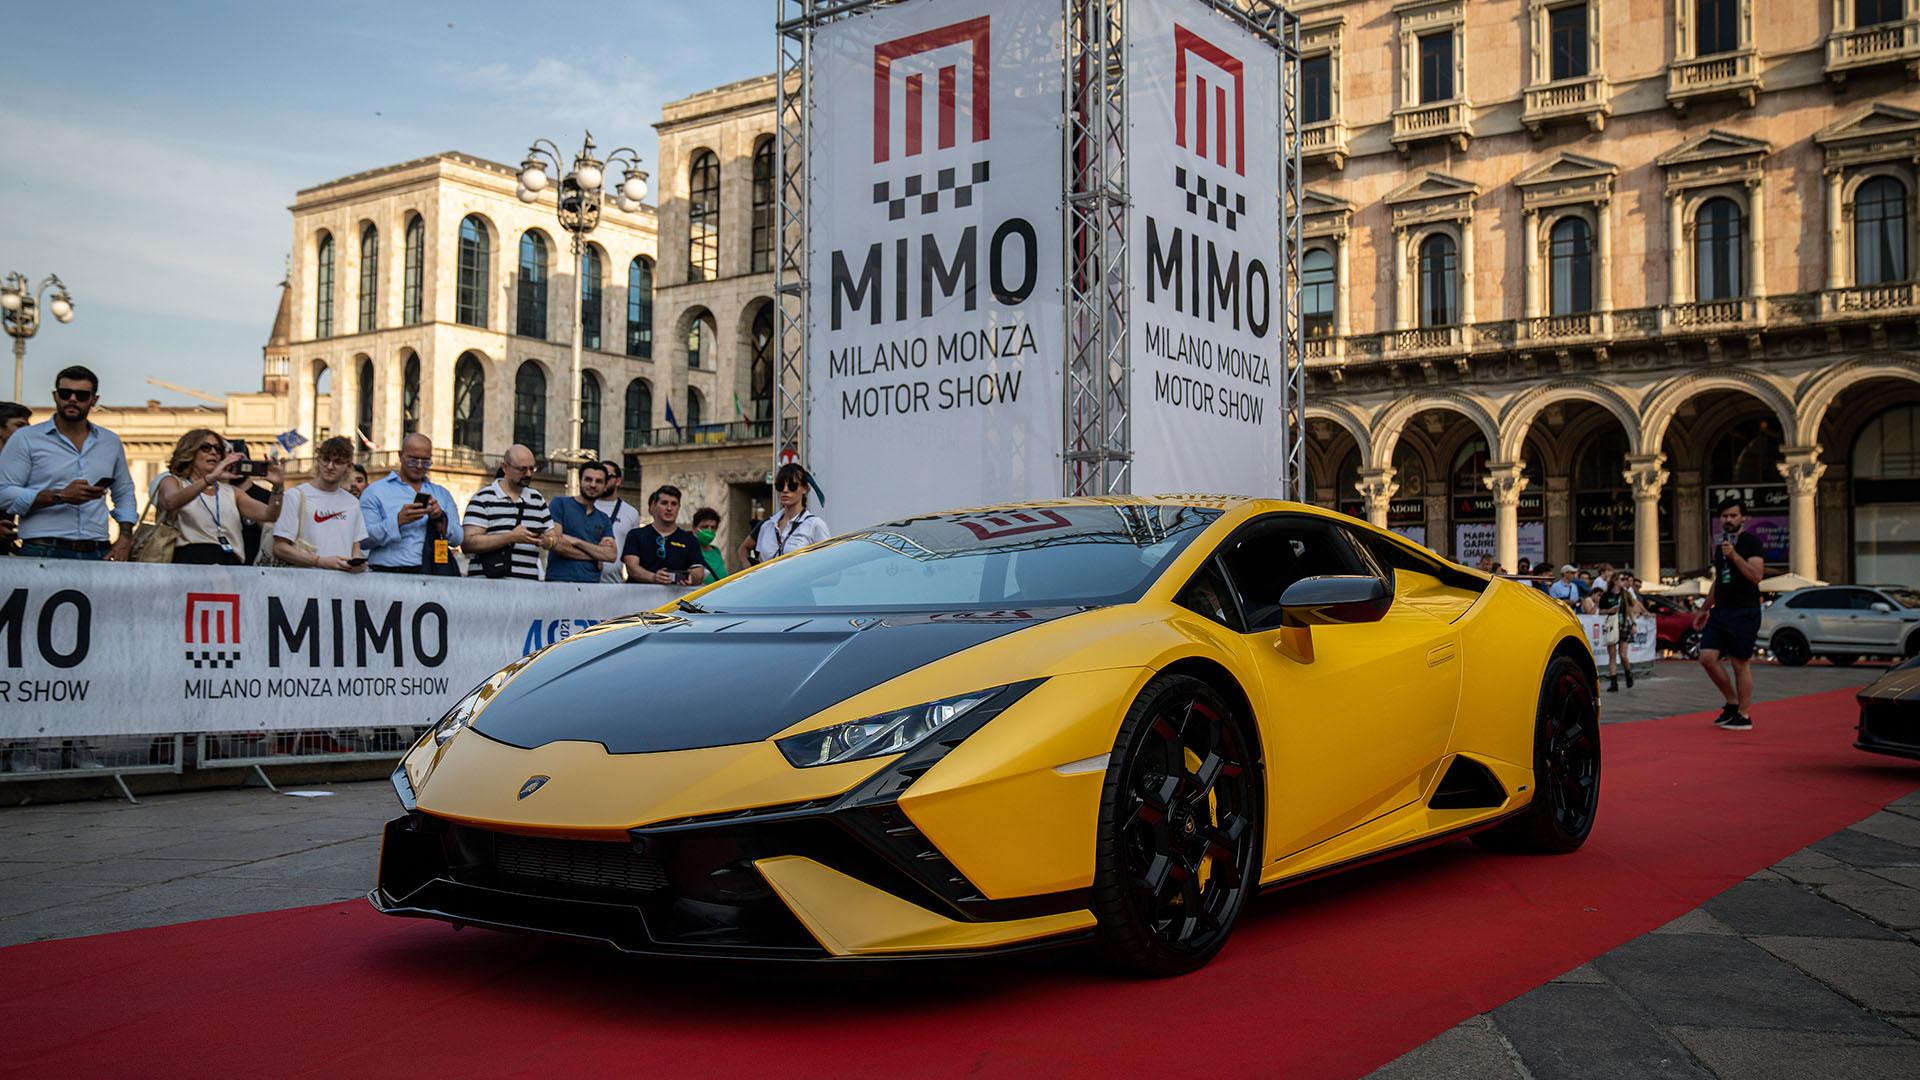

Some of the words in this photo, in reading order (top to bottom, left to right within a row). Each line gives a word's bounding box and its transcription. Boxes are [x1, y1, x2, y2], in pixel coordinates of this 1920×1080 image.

[831, 218, 1037, 331] MIMO
[1147, 216, 1269, 338] MIMO
[830, 338, 928, 379] MILANO
[938, 324, 1038, 365] MONZA
[1146, 322, 1213, 370] MILANO
[1218, 344, 1271, 387] MONZA
[843, 382, 930, 420] MOTOR
[939, 371, 1022, 409] SHOW
[1156, 371, 1215, 414] MOTOR
[1219, 388, 1264, 426] SHOW
[1474, 498, 1540, 510] MOORI
[268, 596, 448, 668] MIMO
[559, 619, 570, 641] 021
[17, 680, 90, 702] SHOW
[185, 679, 261, 700] MILANO
[268, 678, 333, 698] MONZA
[338, 678, 396, 697] MOTOR
[401, 677, 449, 696] SHOW
